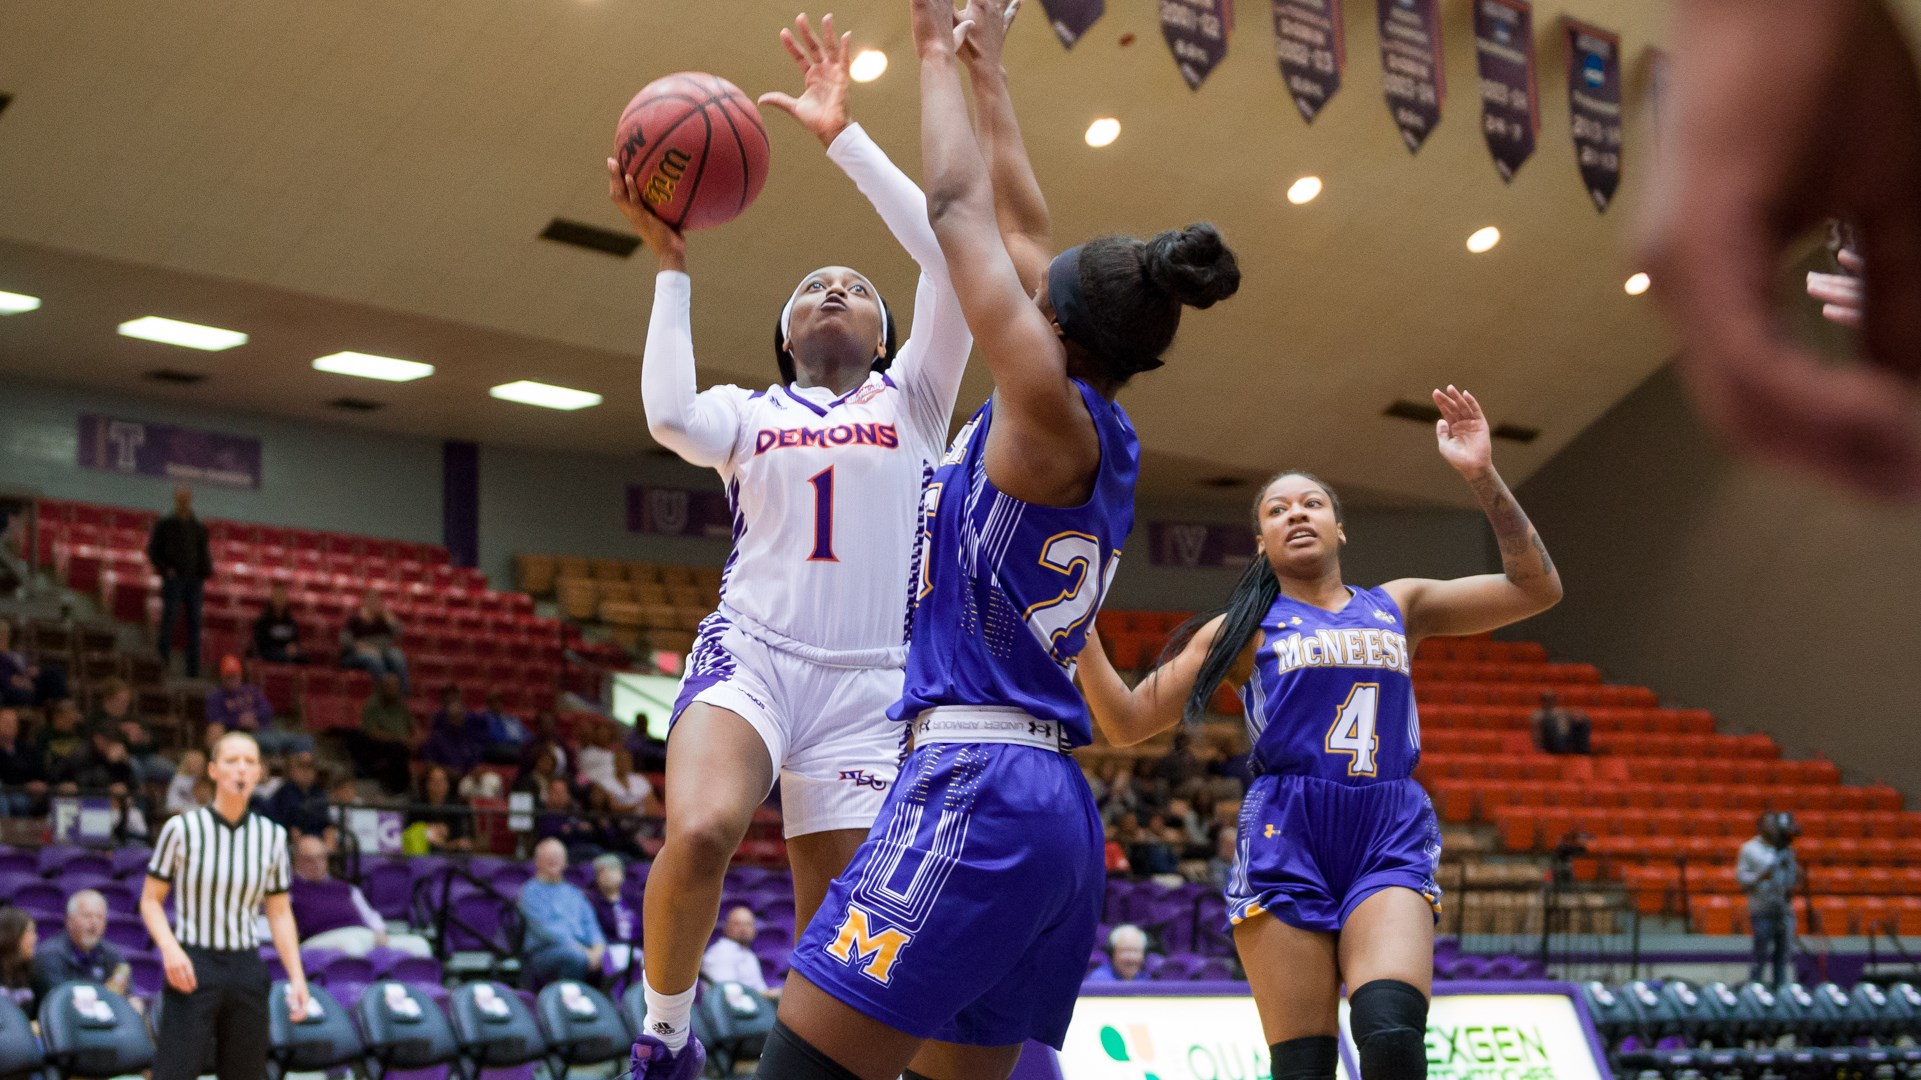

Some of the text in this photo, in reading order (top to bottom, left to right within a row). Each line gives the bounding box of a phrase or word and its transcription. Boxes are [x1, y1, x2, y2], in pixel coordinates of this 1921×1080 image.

[754, 422, 899, 456] DEMONS
[805, 464, 840, 562] 1
[1272, 628, 1409, 676] McNEESE
[933, 719, 1024, 731] UNDER ARMOUR
[1325, 682, 1379, 777] 4
[823, 902, 915, 988] M
